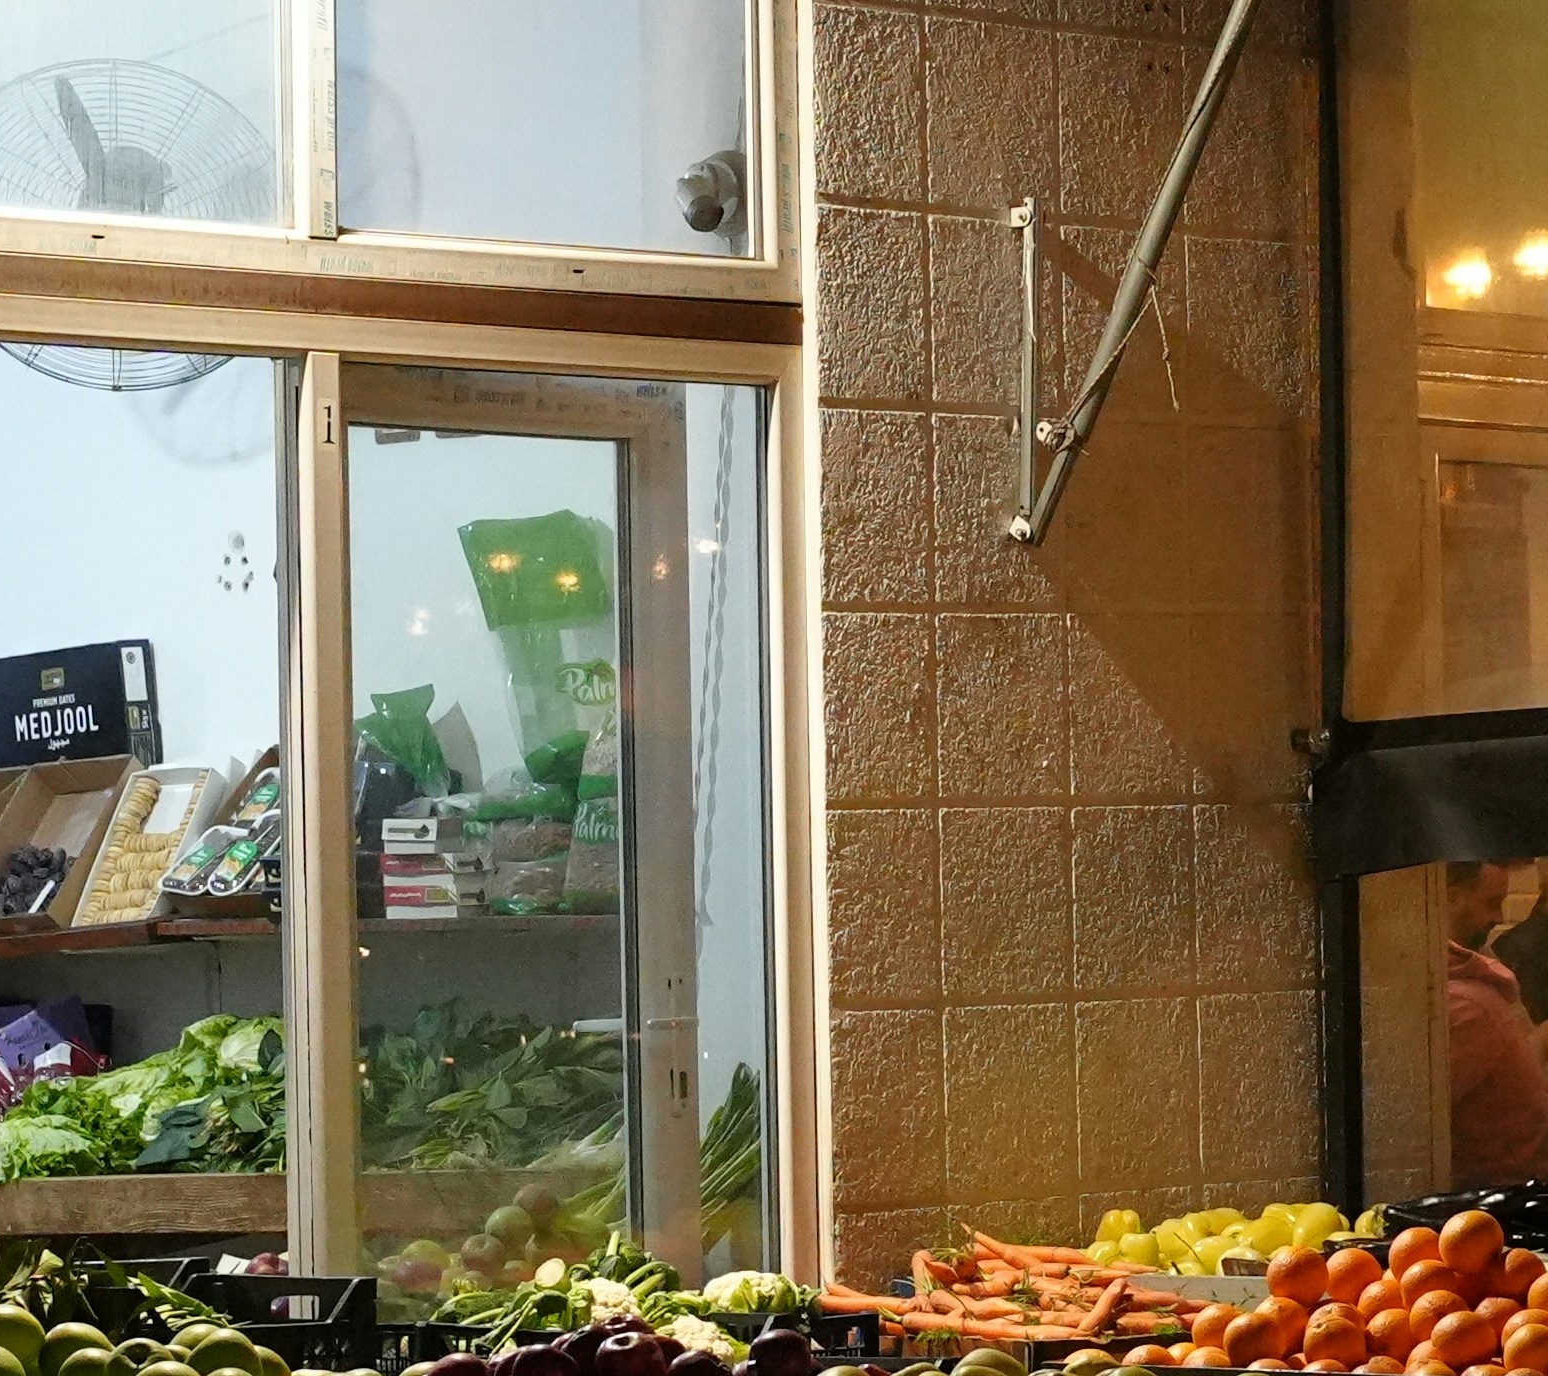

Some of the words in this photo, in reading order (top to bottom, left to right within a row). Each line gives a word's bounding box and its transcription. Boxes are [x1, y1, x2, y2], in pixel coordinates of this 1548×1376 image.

[323, 199, 335, 235] weiss
[32, 696, 58, 708] PREMIUM
[59, 693, 76, 706] DATES
[14, 704, 100, 742] MEDJOOL
